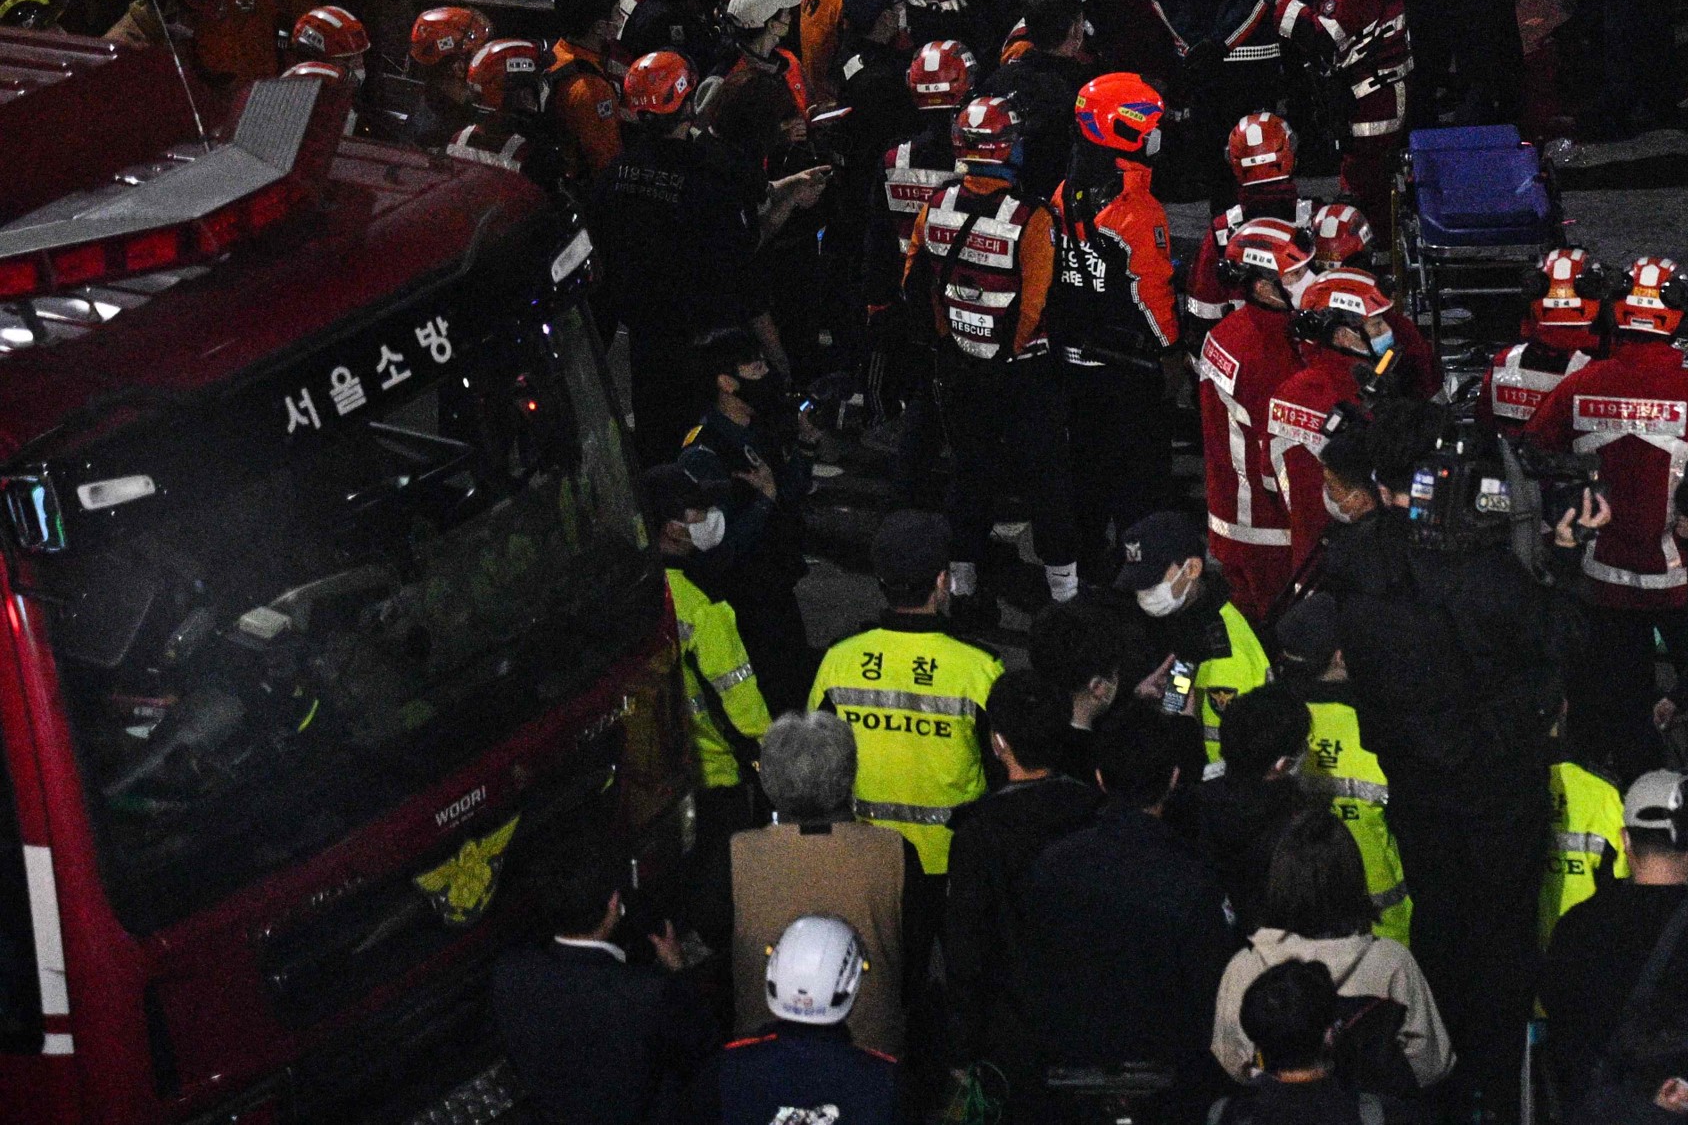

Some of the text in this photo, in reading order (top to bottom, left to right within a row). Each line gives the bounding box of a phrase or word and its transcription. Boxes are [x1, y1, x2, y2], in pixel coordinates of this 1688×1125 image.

[951, 320, 993, 338] RESCUE
[285, 316, 453, 434] 서울소방
[861, 650, 939, 687] 경찰
[844, 711, 953, 739] POLICE
[1316, 738, 1345, 769] 찰
[436, 785, 488, 827] WOORI
